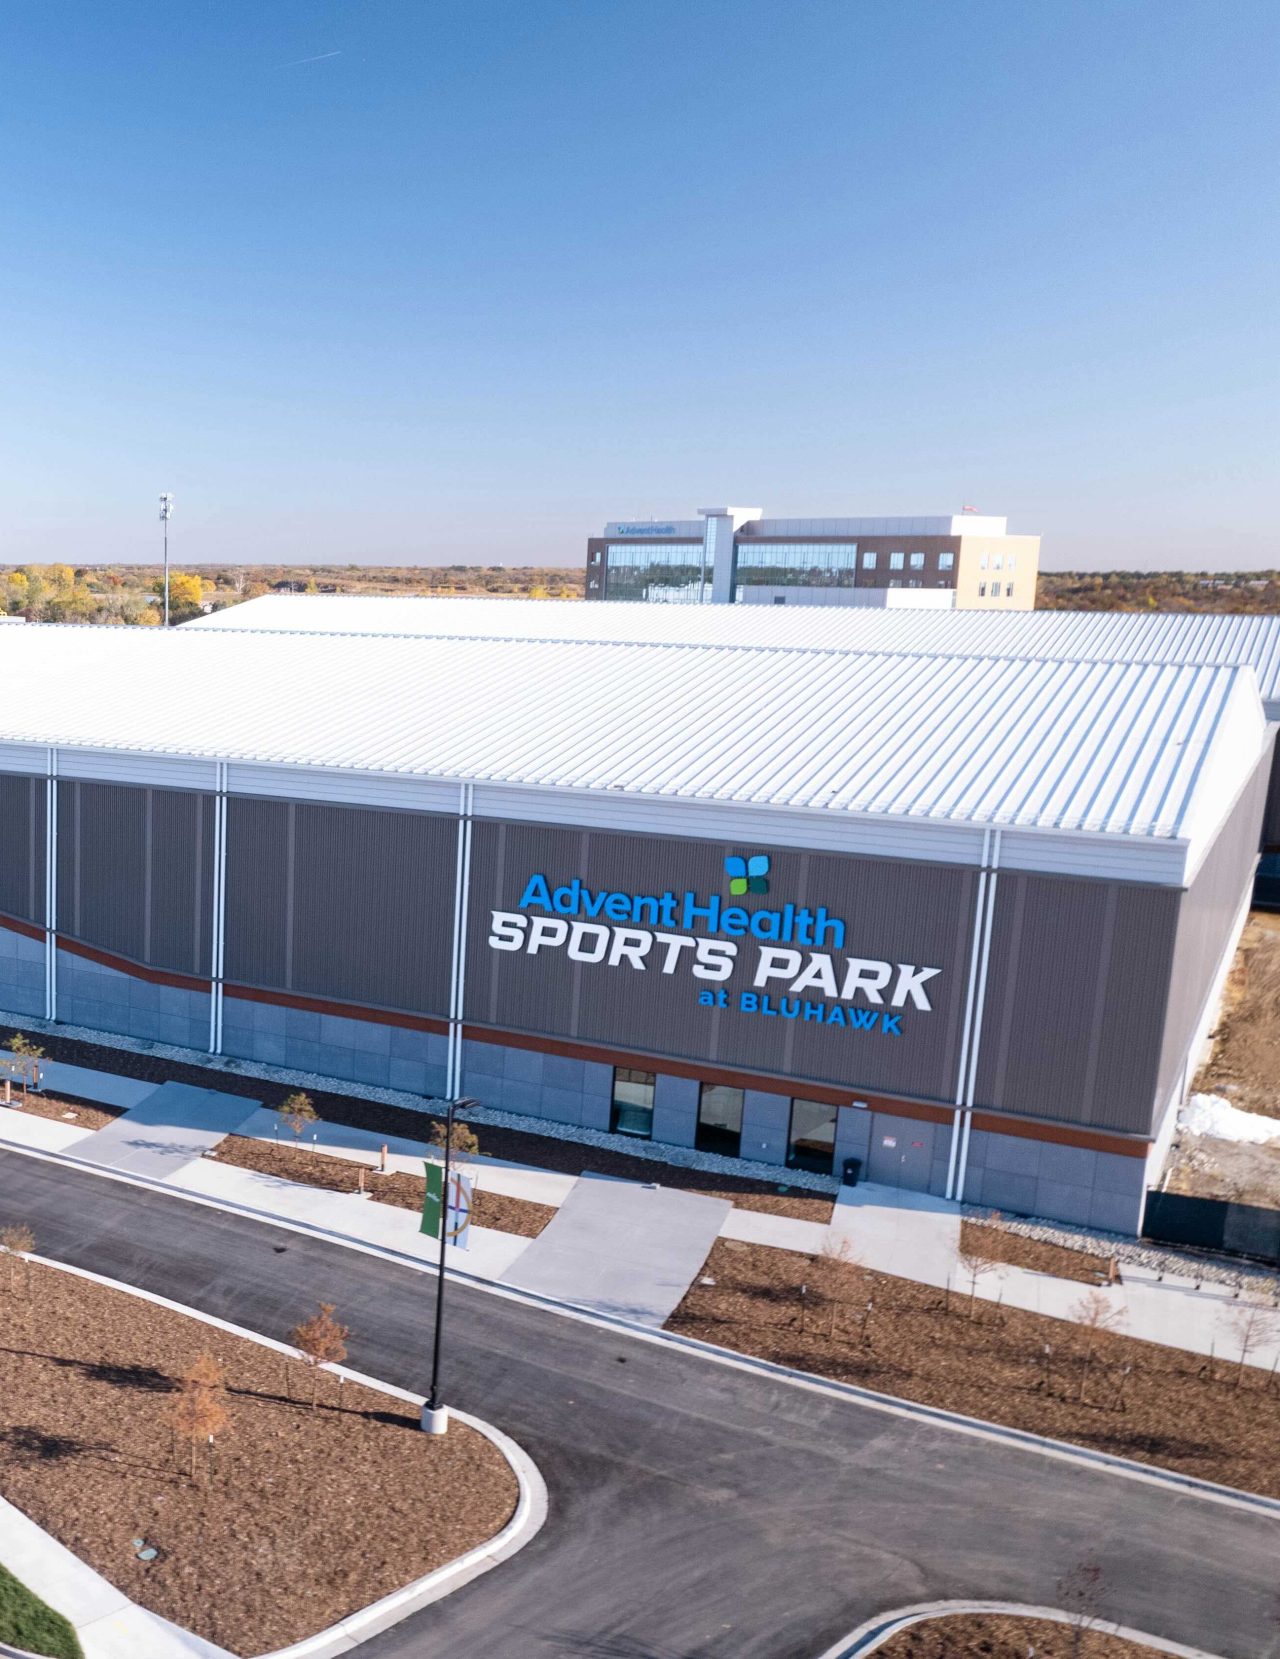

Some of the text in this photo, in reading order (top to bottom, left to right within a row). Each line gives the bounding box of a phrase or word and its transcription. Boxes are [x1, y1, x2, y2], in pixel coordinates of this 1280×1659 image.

[519, 873, 846, 949] AdventHealth
[488, 910, 942, 1011] SPORTS PARK
[698, 988, 903, 1036] at BLUHAWK
